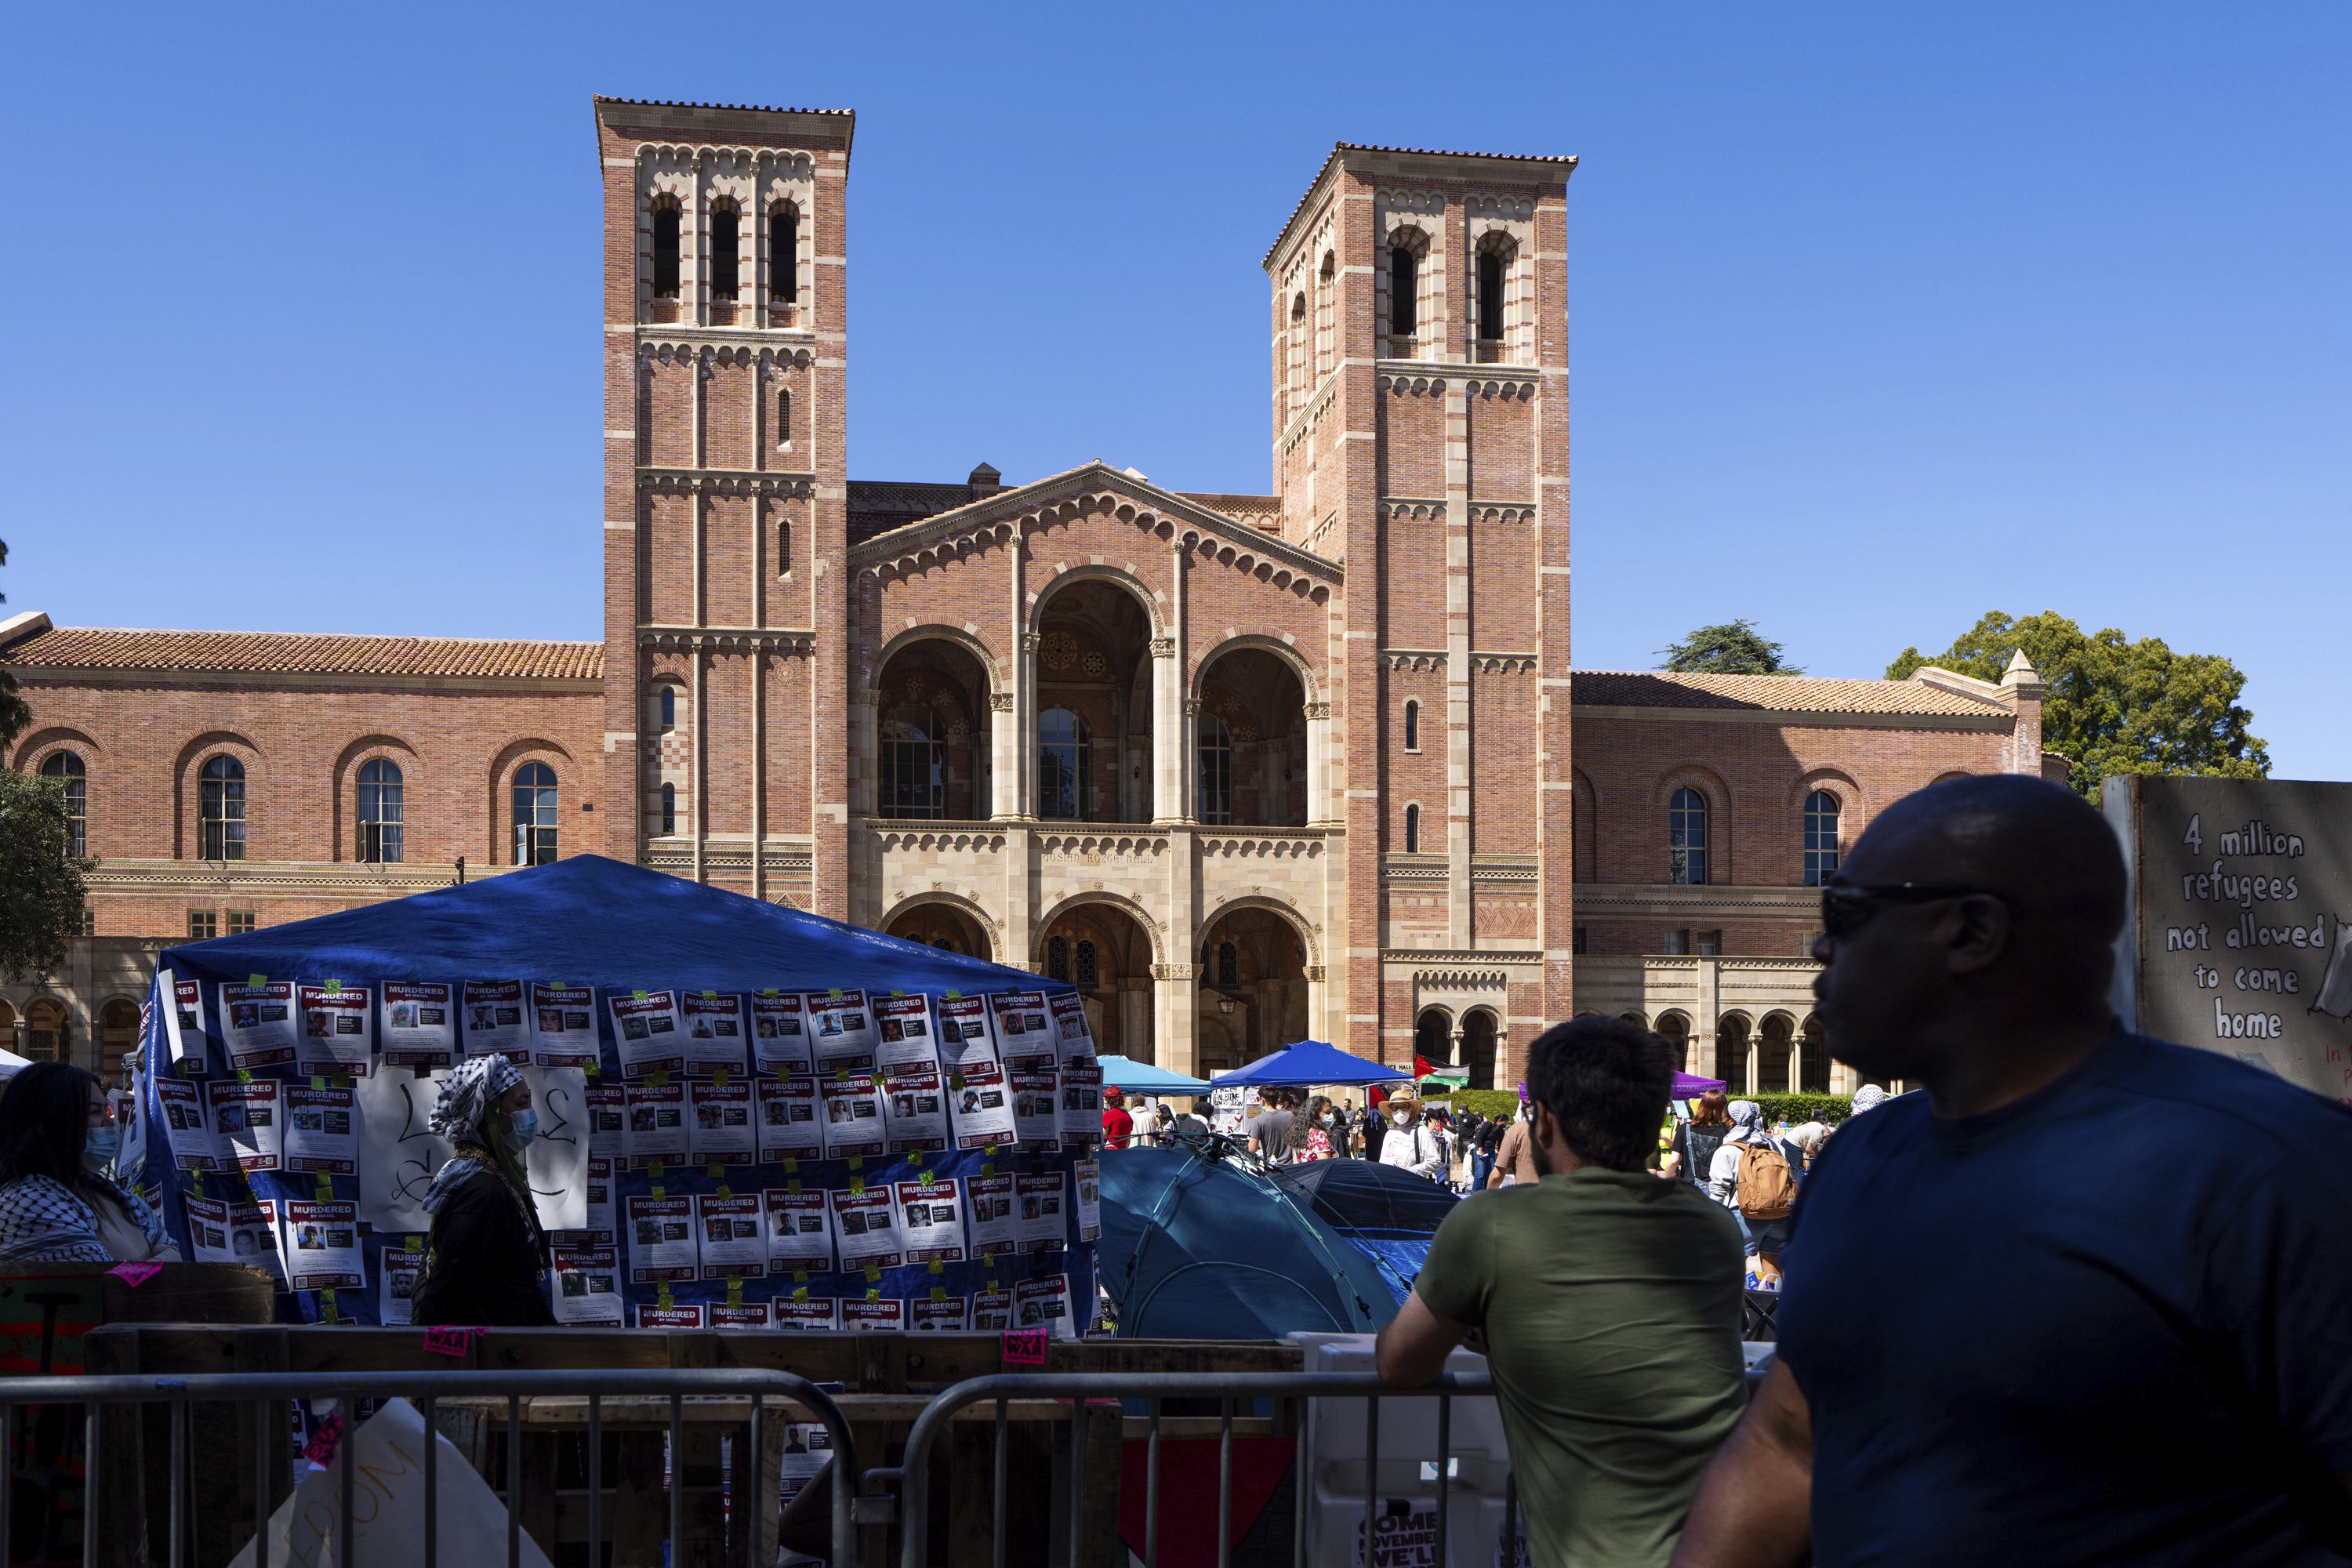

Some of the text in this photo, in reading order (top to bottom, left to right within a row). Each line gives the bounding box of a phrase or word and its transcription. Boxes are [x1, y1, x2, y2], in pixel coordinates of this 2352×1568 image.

[2183, 813, 2304, 858] 4 million
[2182, 859, 2299, 908] refugees
[2166, 912, 2325, 952] not allowed
[2194, 964, 2299, 994] to come
[228, 985, 287, 994] MURDERED
[389, 985, 444, 995] MURDERED
[467, 985, 517, 994] MURDERED
[536, 990, 587, 999] MURDERED
[306, 991, 363, 1000] MURDERED
[811, 994, 859, 1004] MURDERED
[616, 996, 667, 1008] MURDERED
[687, 998, 735, 1007] MURDERED
[753, 996, 797, 1006] MURDERED
[876, 999, 921, 1009] MURDERED
[939, 1000, 978, 1010] MURDERED
[2213, 996, 2283, 1040] home
[823, 1080, 871, 1089] MURDERED
[887, 1076, 935, 1084] MURDERED
[158, 1083, 193, 1094] MURDERED
[214, 1084, 272, 1094] MURDERED
[762, 1082, 810, 1091] MURDERED
[292, 1090, 348, 1099] MURDERED
[970, 1178, 1009, 1188] MURDERED
[1019, 1177, 1059, 1185] MURDERED
[902, 1185, 951, 1194] MURDERED
[837, 1191, 885, 1202] MURDERED
[187, 1197, 223, 1214] MURDERED
[558, 1253, 611, 1261] MURDERED
[1018, 1279, 1062, 1292] MURDERED
[976, 1294, 1009, 1304] MURDERED
[779, 1301, 829, 1311] MURDERED
[846, 1303, 896, 1312] MURDERED
[916, 1302, 961, 1311] MURDERED
[643, 1310, 695, 1319] MURDERED
[713, 1307, 764, 1316] MURDERED
[1007, 1345, 1042, 1356] WAR
